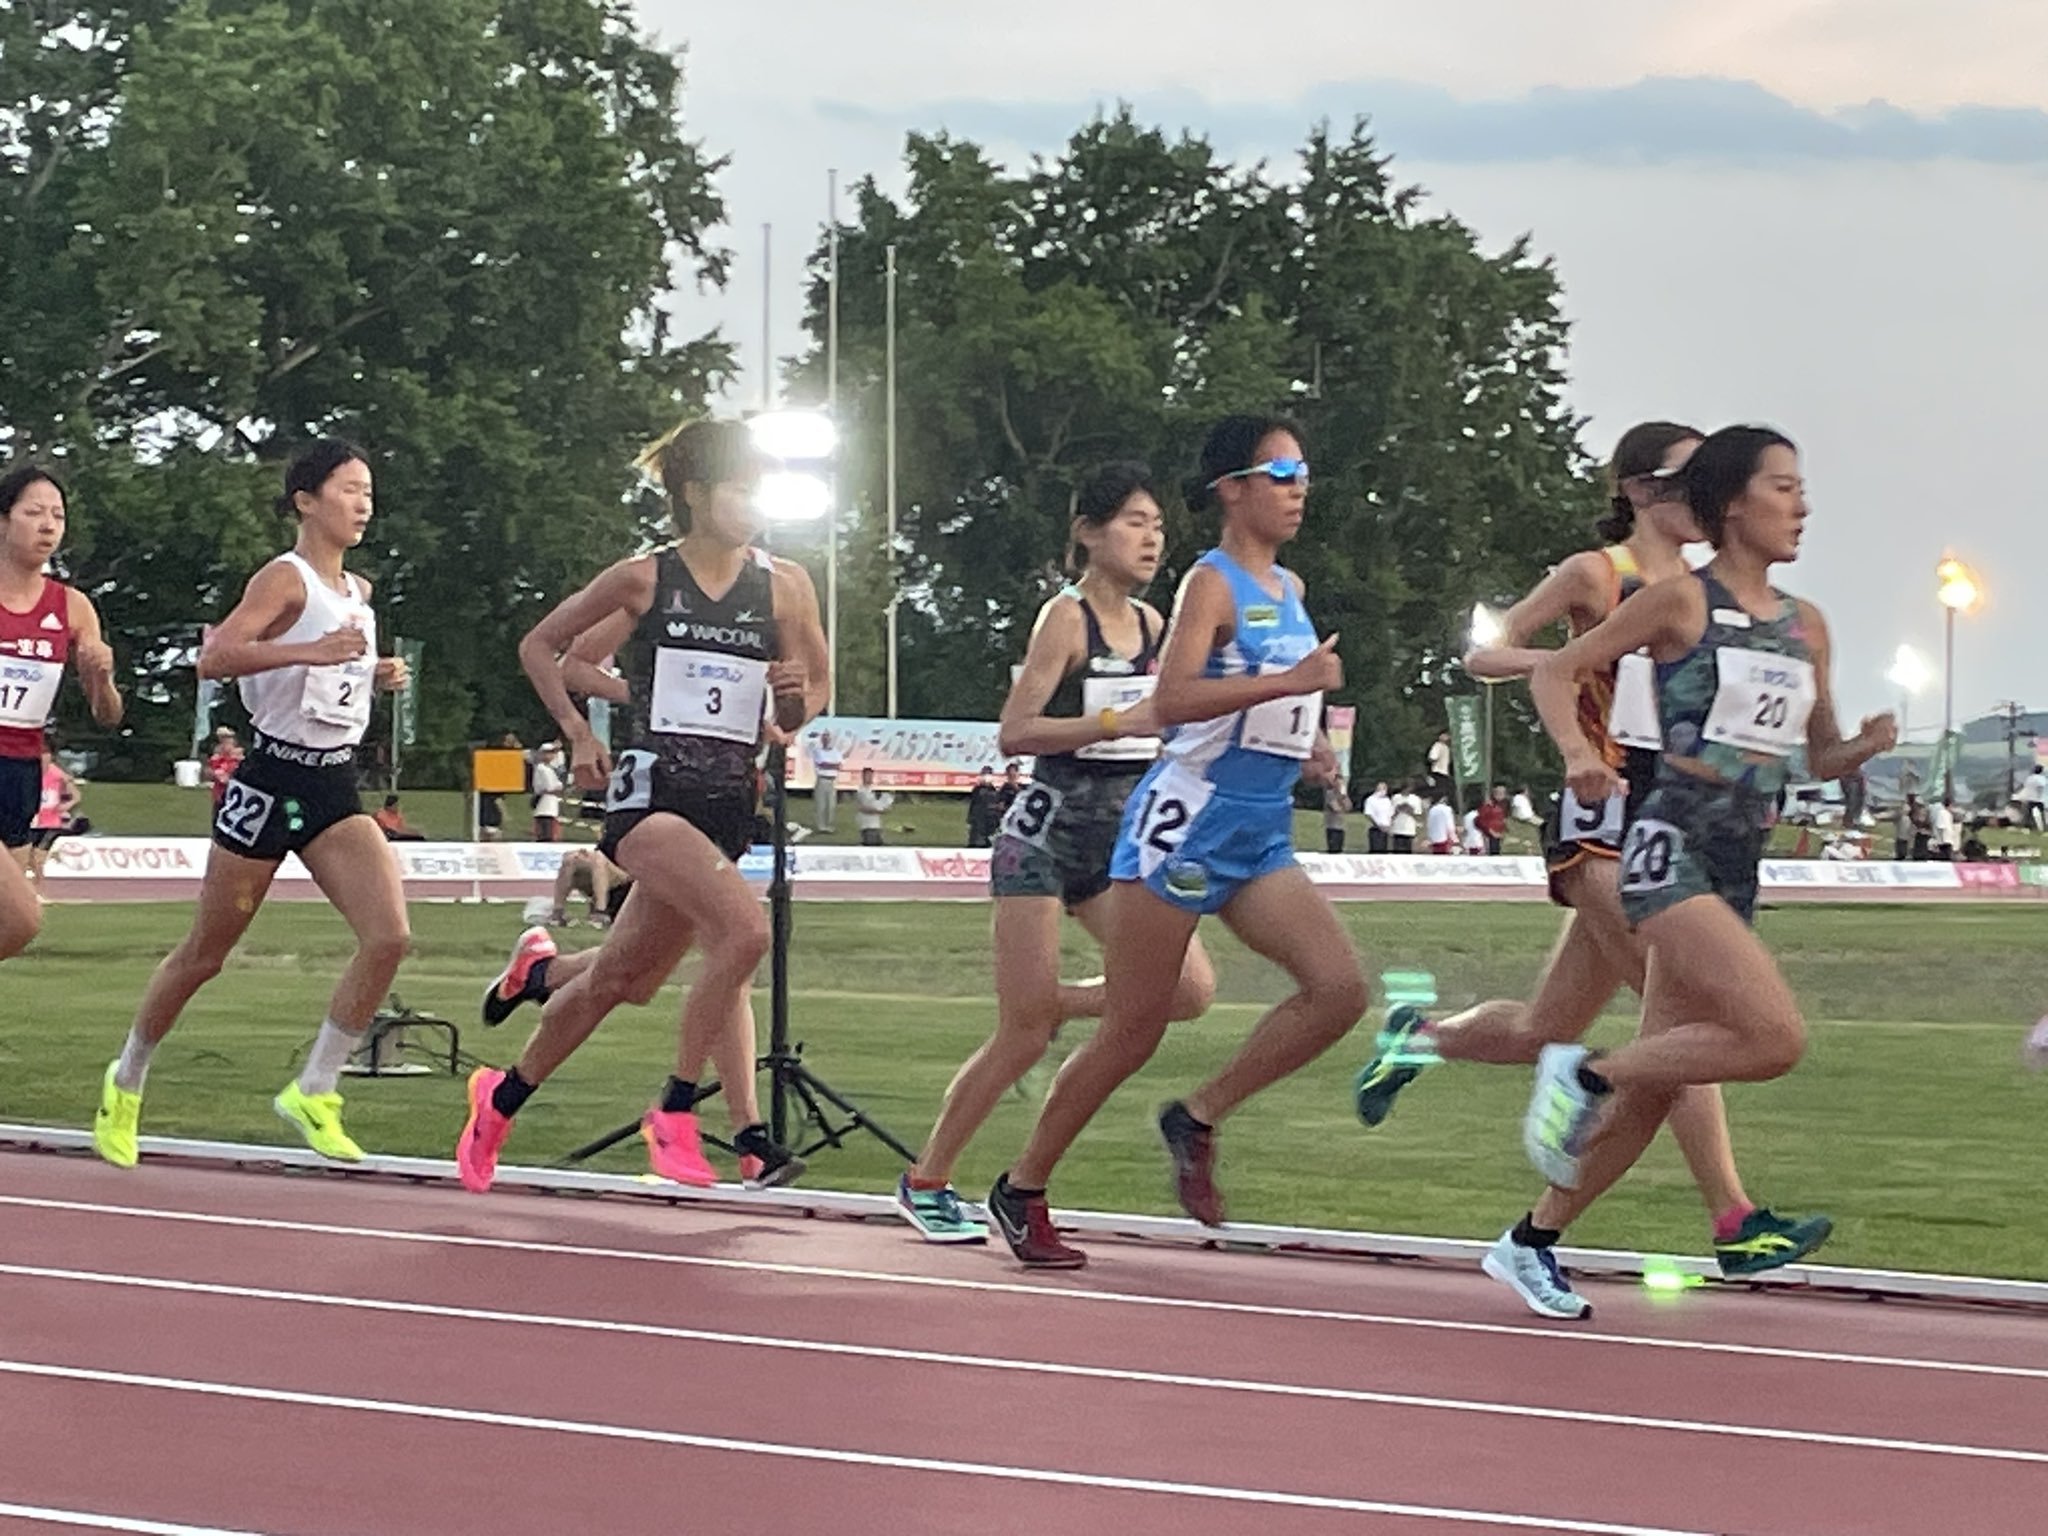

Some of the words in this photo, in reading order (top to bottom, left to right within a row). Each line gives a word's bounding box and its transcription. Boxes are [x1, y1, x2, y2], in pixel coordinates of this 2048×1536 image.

[0, 684, 29, 710] 17
[705, 687, 723, 715] 3
[1754, 693, 1788, 729] 20
[265, 741, 321, 767] NIKE
[613, 754, 638, 803] 3
[221, 786, 267, 841] 22
[1135, 789, 1187, 853] 12
[95, 847, 193, 869] TOYOTA
[1625, 826, 1671, 884] 20
